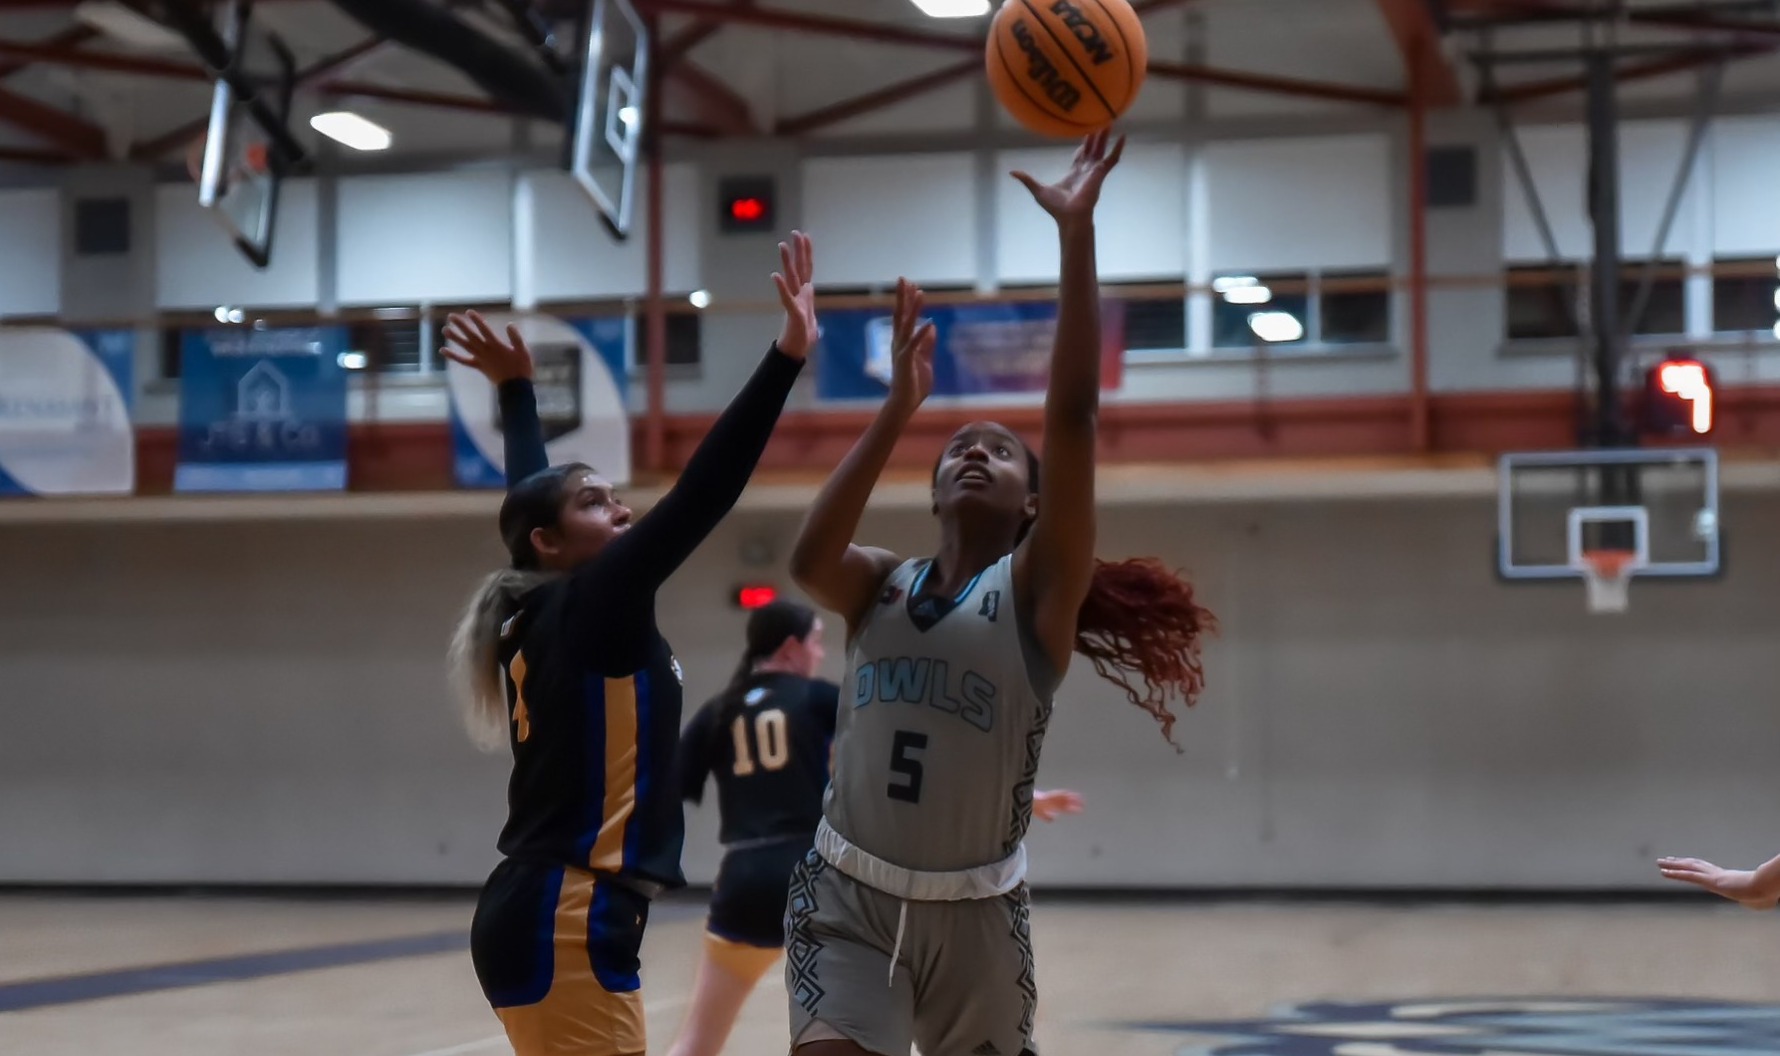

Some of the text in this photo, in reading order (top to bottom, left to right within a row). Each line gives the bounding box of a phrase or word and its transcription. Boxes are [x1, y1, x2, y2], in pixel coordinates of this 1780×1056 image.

[1011, 19, 1081, 112] Wilson
[1051, 0, 1113, 66] NCAA
[853, 656, 997, 733] OWLS
[731, 708, 790, 777] 10
[887, 729, 928, 805] 5
